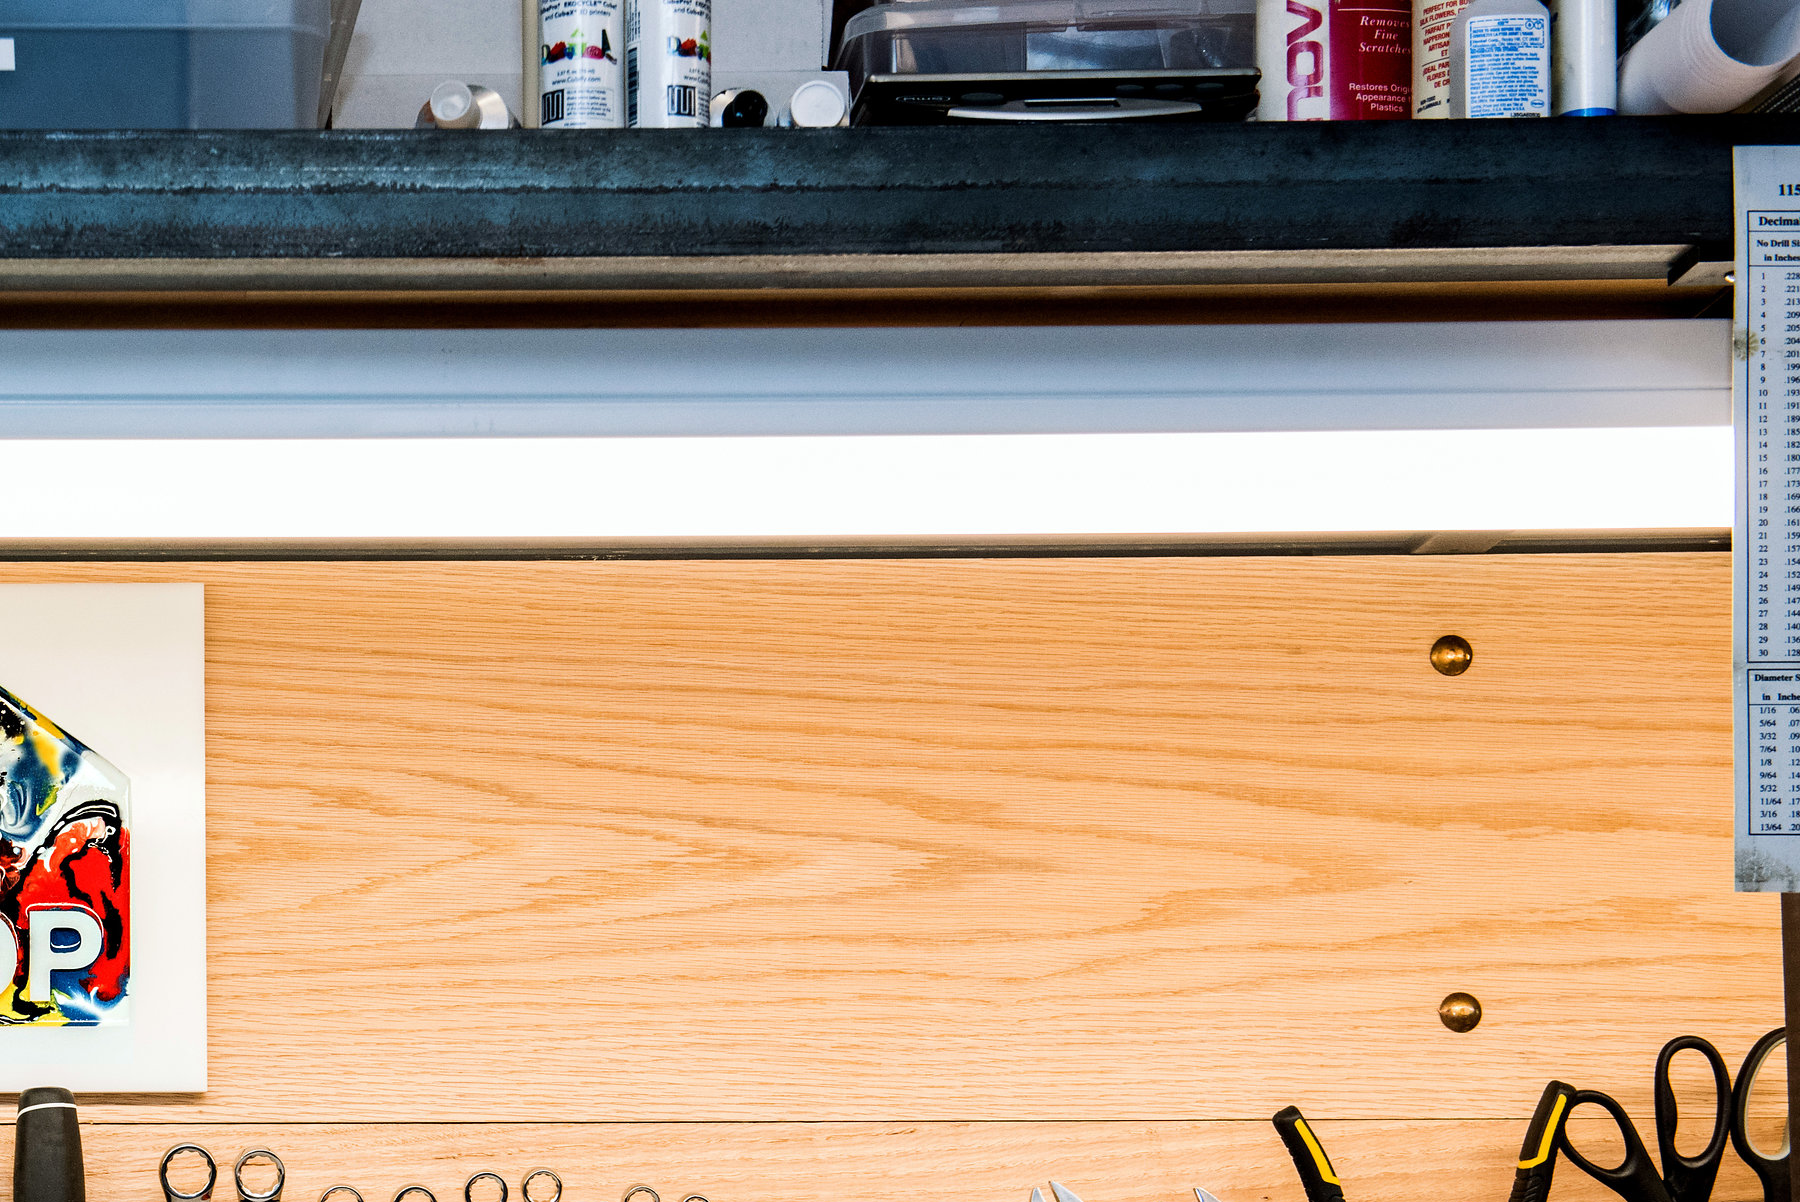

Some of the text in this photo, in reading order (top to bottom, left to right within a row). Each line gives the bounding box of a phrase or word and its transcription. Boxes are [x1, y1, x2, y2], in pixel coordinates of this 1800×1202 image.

[1445, 0, 1458, 10] FOR
[1360, 15, 1411, 27] Removes
[1374, 29, 1399, 40] Fine
[1349, 82, 1388, 91] Restores
[1356, 92, 1406, 103] Appearance
[1370, 103, 1404, 113] Plastics
[1759, 216, 1800, 226] Decima
[1761, 272, 1766, 280] 1
[1761, 285, 1766, 293] 2
[1761, 298, 1766, 306] 3
[1761, 311, 1766, 319] 4
[1761, 324, 1766, 332] 5
[1761, 337, 1766, 345] 6
[1761, 350, 1766, 358] 7
[1761, 363, 1766, 371] 8
[1761, 376, 1766, 384] 9
[1758, 389, 1768, 397] 10
[1758, 402, 1768, 410] 11
[1758, 415, 1768, 423] 12
[1758, 428, 1768, 436] 13
[1759, 707, 1777, 715] 1/16
[1759, 720, 1777, 728] 5/64
[1759, 732, 1777, 740] 3/32
[1759, 746, 1777, 754] 7/64
[1759, 759, 1773, 767] 1/8
[1759, 772, 1777, 780] 9/64
[1759, 785, 1777, 793] 5/32
[1759, 798, 1783, 806] 11/64
[1759, 810, 1777, 818] 3/16
[1759, 824, 1783, 832] 13/64
